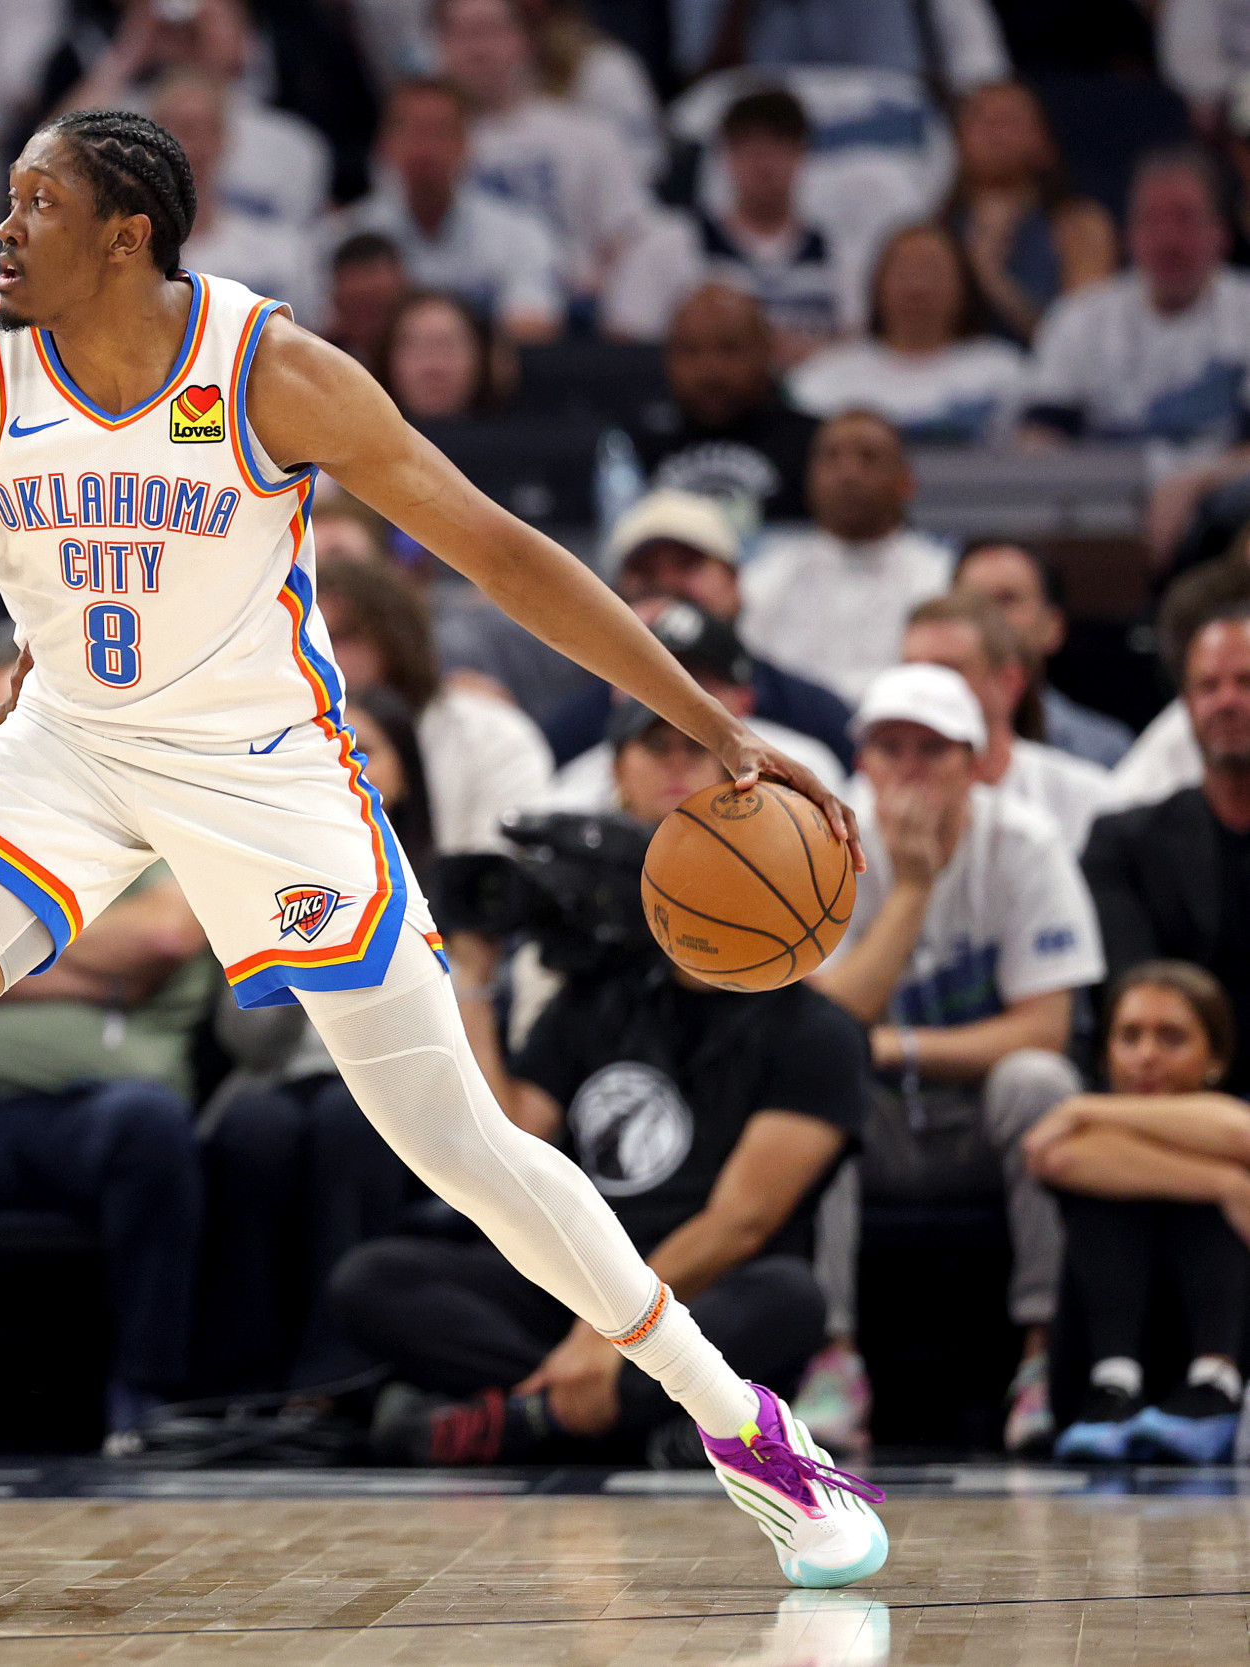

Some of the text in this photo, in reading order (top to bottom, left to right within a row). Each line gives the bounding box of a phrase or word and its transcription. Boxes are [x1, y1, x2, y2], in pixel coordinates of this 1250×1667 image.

[59, 538, 165, 594] CITY
[83, 600, 141, 689] 8
[281, 894, 324, 931] OKC
